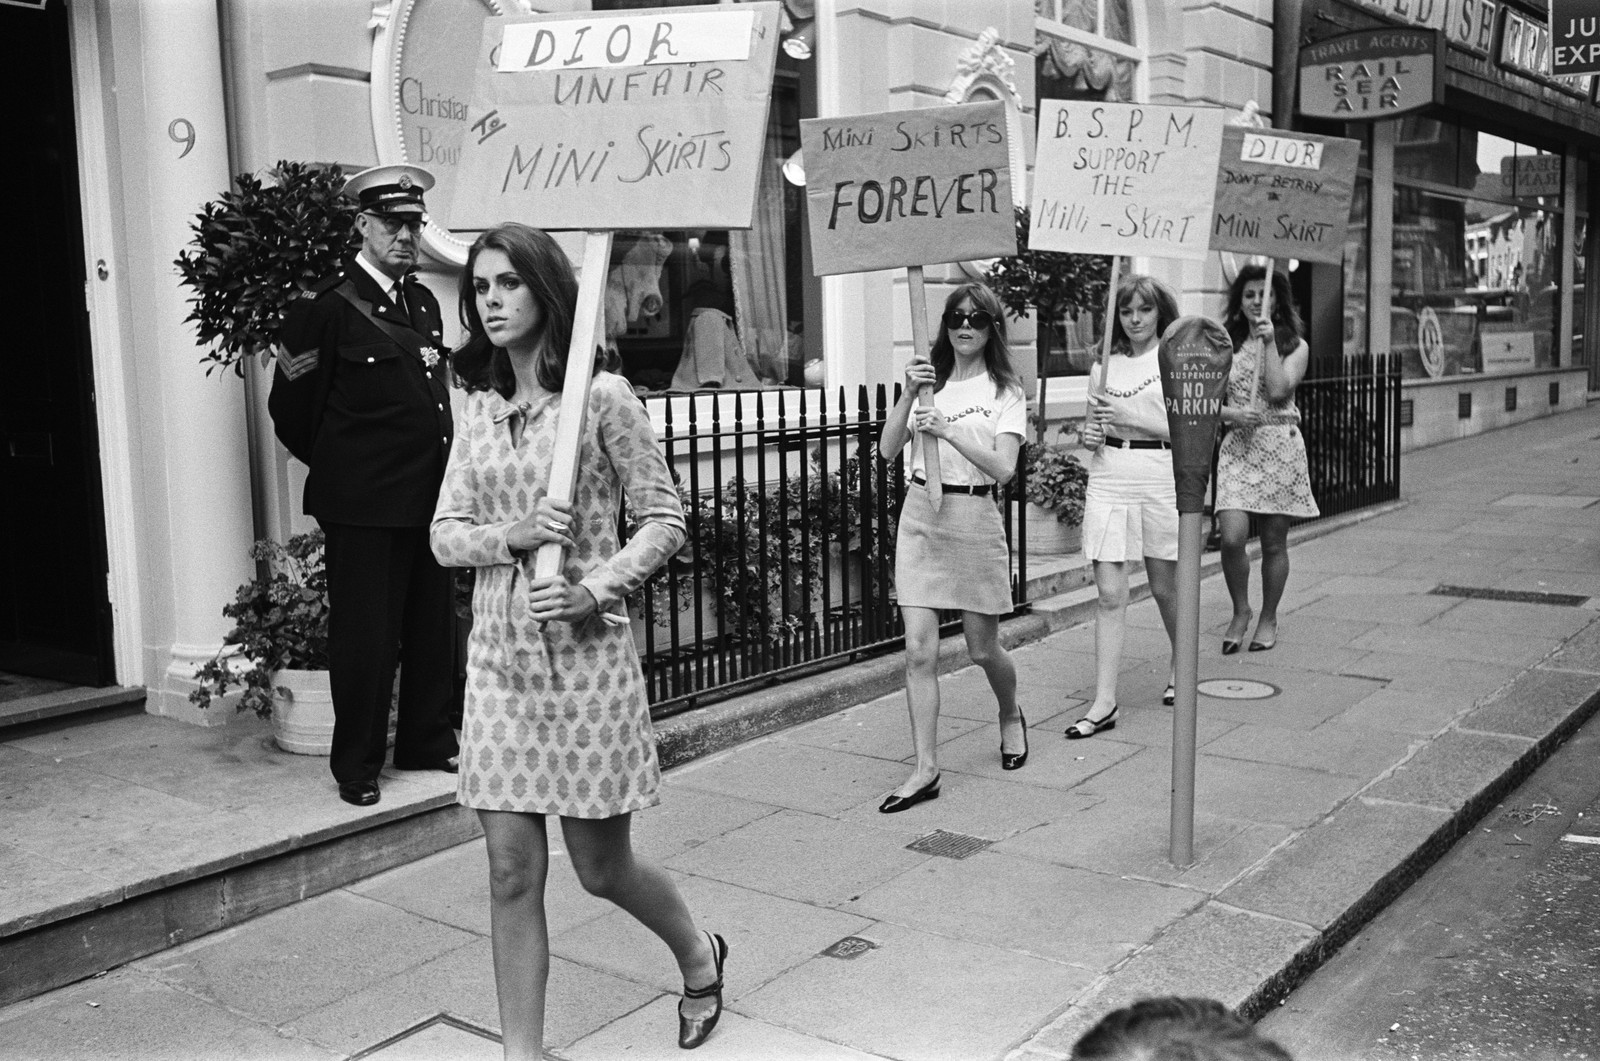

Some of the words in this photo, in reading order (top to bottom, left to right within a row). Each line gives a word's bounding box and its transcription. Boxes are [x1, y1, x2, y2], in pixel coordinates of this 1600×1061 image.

[524, 22, 678, 67] DIOR
[1311, 39, 1359, 61] TRAVEL
[1369, 34, 1429, 50] AGENTS
[1555, 43, 1600, 66] EXP
[1325, 61, 1410, 81] RAIL
[1333, 76, 1401, 97] SEA
[1333, 92, 1398, 113] AIR
[168, 118, 195, 159] 9
[1054, 108, 1072, 138] B.
[1087, 107, 1109, 139] S.
[1126, 108, 1144, 142] P.
[1164, 112, 1198, 149] M.
[1073, 147, 1166, 174] SUPPORT
[1248, 138, 1316, 166] DIOR
[1092, 174, 1137, 196] THE
[1270, 175, 1323, 194] BETRAY
[828, 168, 999, 230] FOREVER
[1170, 371, 1223, 380] SUSPENDED
[1183, 363, 1207, 371] BAY
[1183, 382, 1204, 398] NO
[1165, 397, 1220, 415] PARKIN
